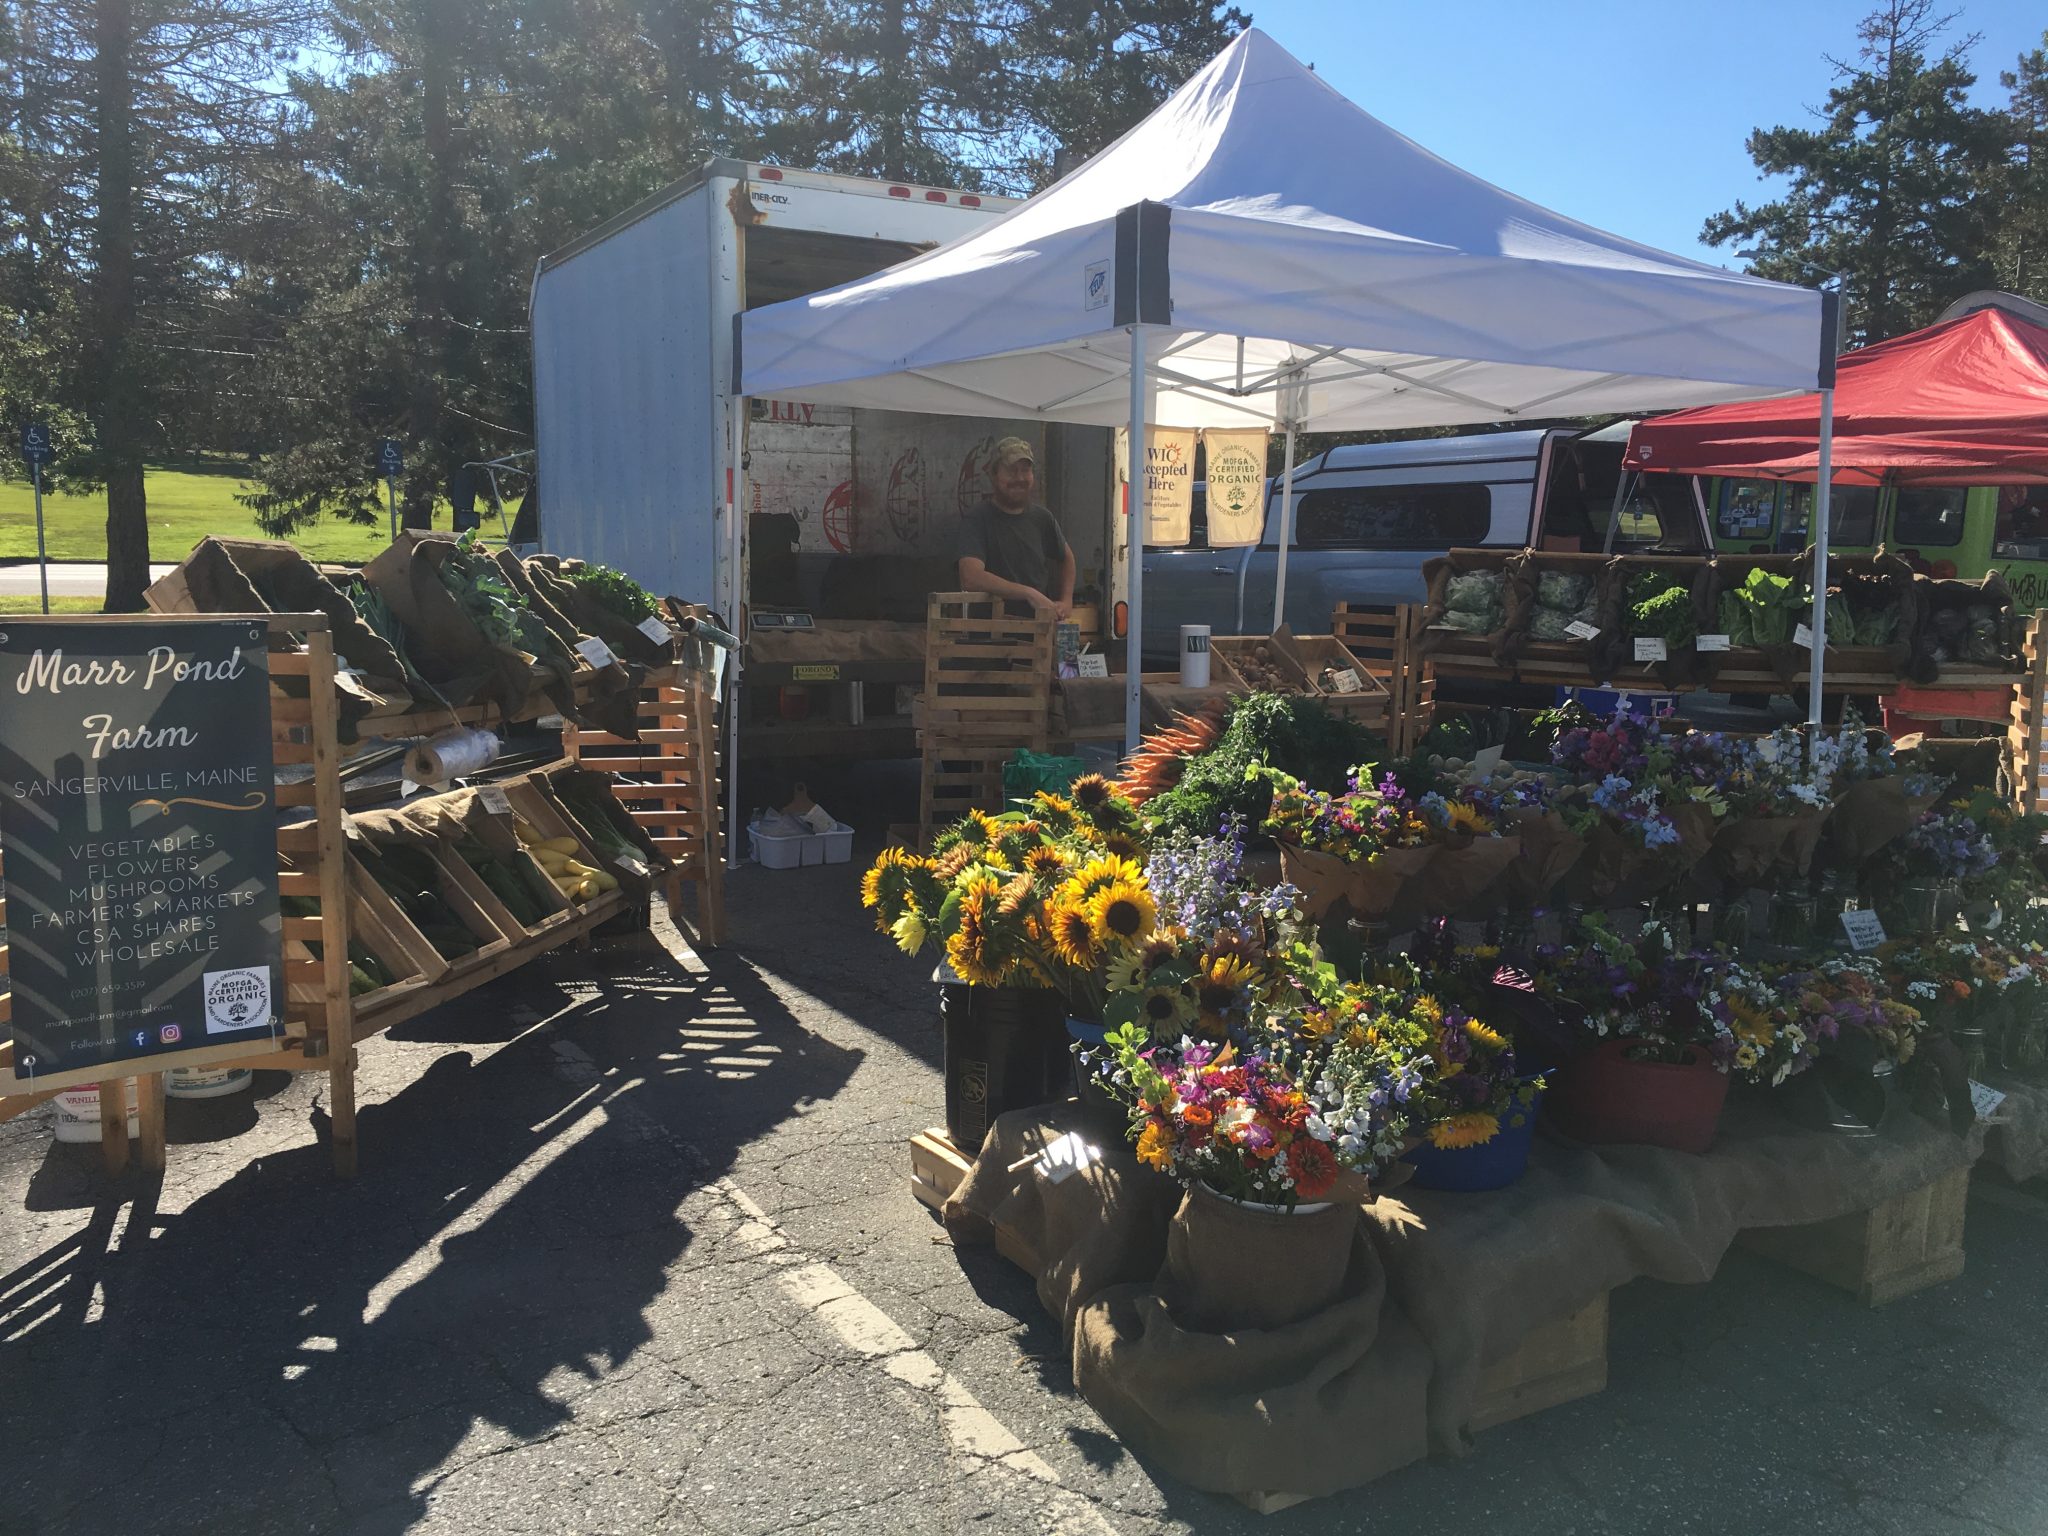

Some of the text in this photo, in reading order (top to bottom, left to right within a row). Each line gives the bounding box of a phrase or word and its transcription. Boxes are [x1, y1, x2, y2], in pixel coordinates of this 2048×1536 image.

[1147, 447, 1178, 463] WIC
[1143, 463, 1187, 478] ccepted
[1215, 465, 1255, 473] CERTIFIED
[1148, 476, 1175, 491] Here
[1209, 474, 1261, 484] ORGANIC
[16, 646, 245, 695] Marr Pond
[82, 714, 198, 759] Farm
[14, 766, 258, 799] SANGERVILLE, MAINE
[69, 833, 215, 861] VEGETABLES
[88, 855, 199, 880] FLOWERS
[69, 874, 219, 904] MUSHROOMS
[32, 890, 255, 929] FARMER'S MARKETS
[76, 915, 216, 946] CSA SHARES
[75, 935, 219, 967] WHOLESALE
[220, 971, 246, 981] ORGANIC
[215, 985, 259, 996] CERTIFIED
[221, 980, 252, 989] MOFGA
[208, 991, 267, 1005] ORGANIC
[70, 1038, 105, 1051] Follow
[66, 1096, 99, 1104] VANILL
